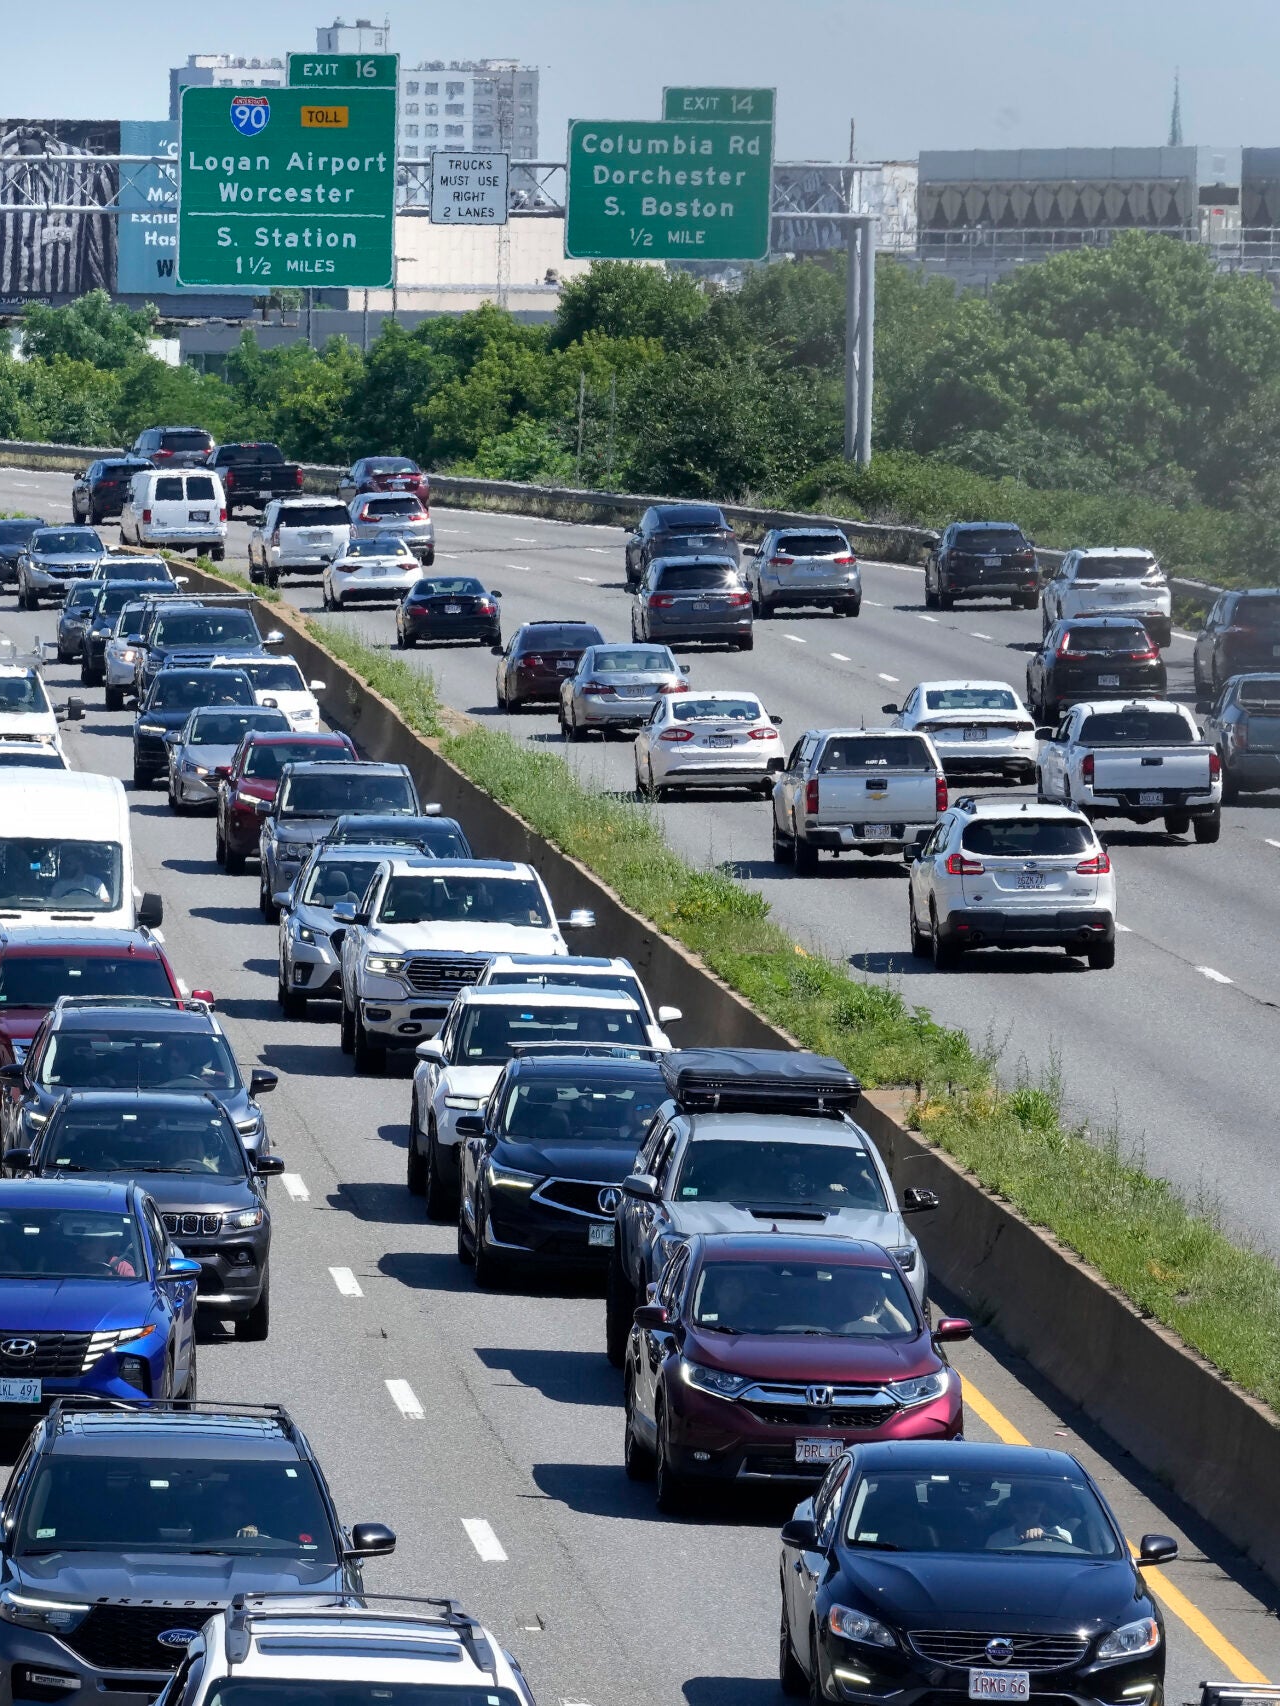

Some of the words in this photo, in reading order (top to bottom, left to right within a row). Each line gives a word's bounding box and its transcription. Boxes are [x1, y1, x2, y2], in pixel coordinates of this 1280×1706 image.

[303, 63, 339, 76] EXIT
[355, 60, 377, 78] 16
[683, 97, 719, 110] EXIT
[730, 95, 754, 114] 14
[235, 106, 266, 128] 90
[307, 110, 342, 123] TOLL
[582, 134, 713, 154] Columbia
[729, 135, 760, 155] Rd
[189, 152, 269, 175] Logan
[286, 152, 387, 176] Airport
[449, 160, 492, 170] TRUCKS
[440, 176, 470, 186] MUST
[478, 176, 499, 186] USE
[593, 165, 746, 186] Dorchester
[219, 182, 355, 203] Worcester
[453, 191, 485, 202] RIGHT
[443, 207, 451, 217] 2
[458, 207, 494, 217] LANES
[604, 196, 626, 216] S.
[641, 197, 734, 217] Boston
[217, 227, 238, 247] S.
[254, 227, 357, 248] Station
[667, 230, 705, 244] MILE
[286, 260, 335, 273] MILES
[444, 970, 482, 978] RA
[20, 1384, 38, 1396] 497
[797, 1445, 825, 1457] 7BRL
[96, 1597, 263, 1606] EXPLORR
[167, 1632, 193, 1643] Ford
[973, 1677, 1007, 1693] 1RKG
[1010, 1678, 1026, 1694] 66
